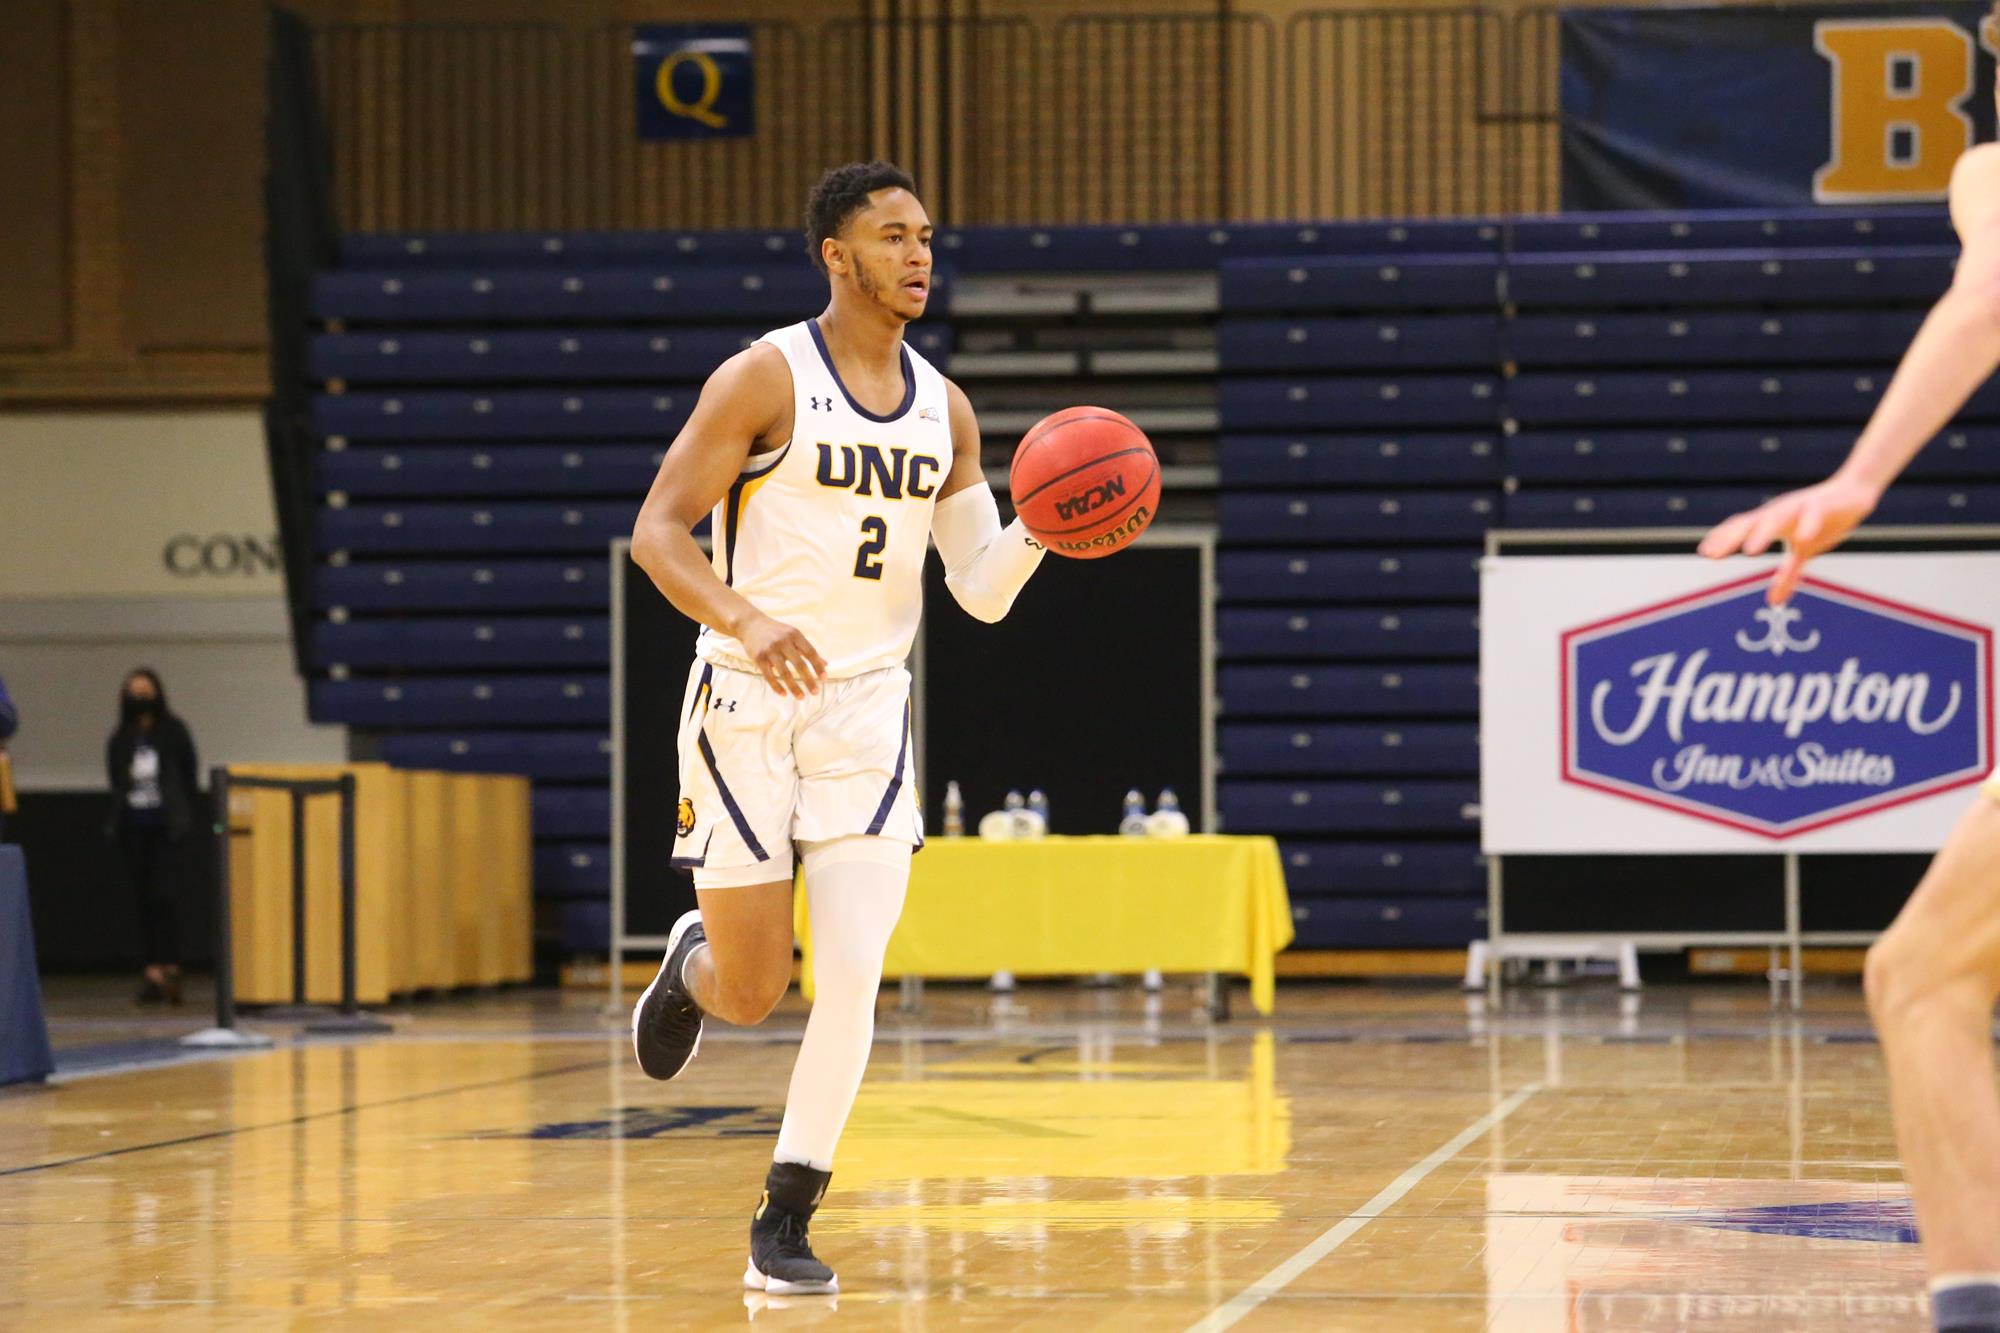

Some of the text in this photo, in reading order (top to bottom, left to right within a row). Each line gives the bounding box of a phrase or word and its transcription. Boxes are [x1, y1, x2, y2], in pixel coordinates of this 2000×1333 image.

[655, 50, 728, 129] Q
[1813, 18, 2000, 205] B
[815, 440, 941, 501] UNC
[1054, 474, 1126, 521] NCAA
[852, 514, 888, 581] 2
[1056, 505, 1150, 551] Wilson
[1591, 648, 1962, 746] Hampton
[1652, 742, 1895, 792] Inn & Suites
